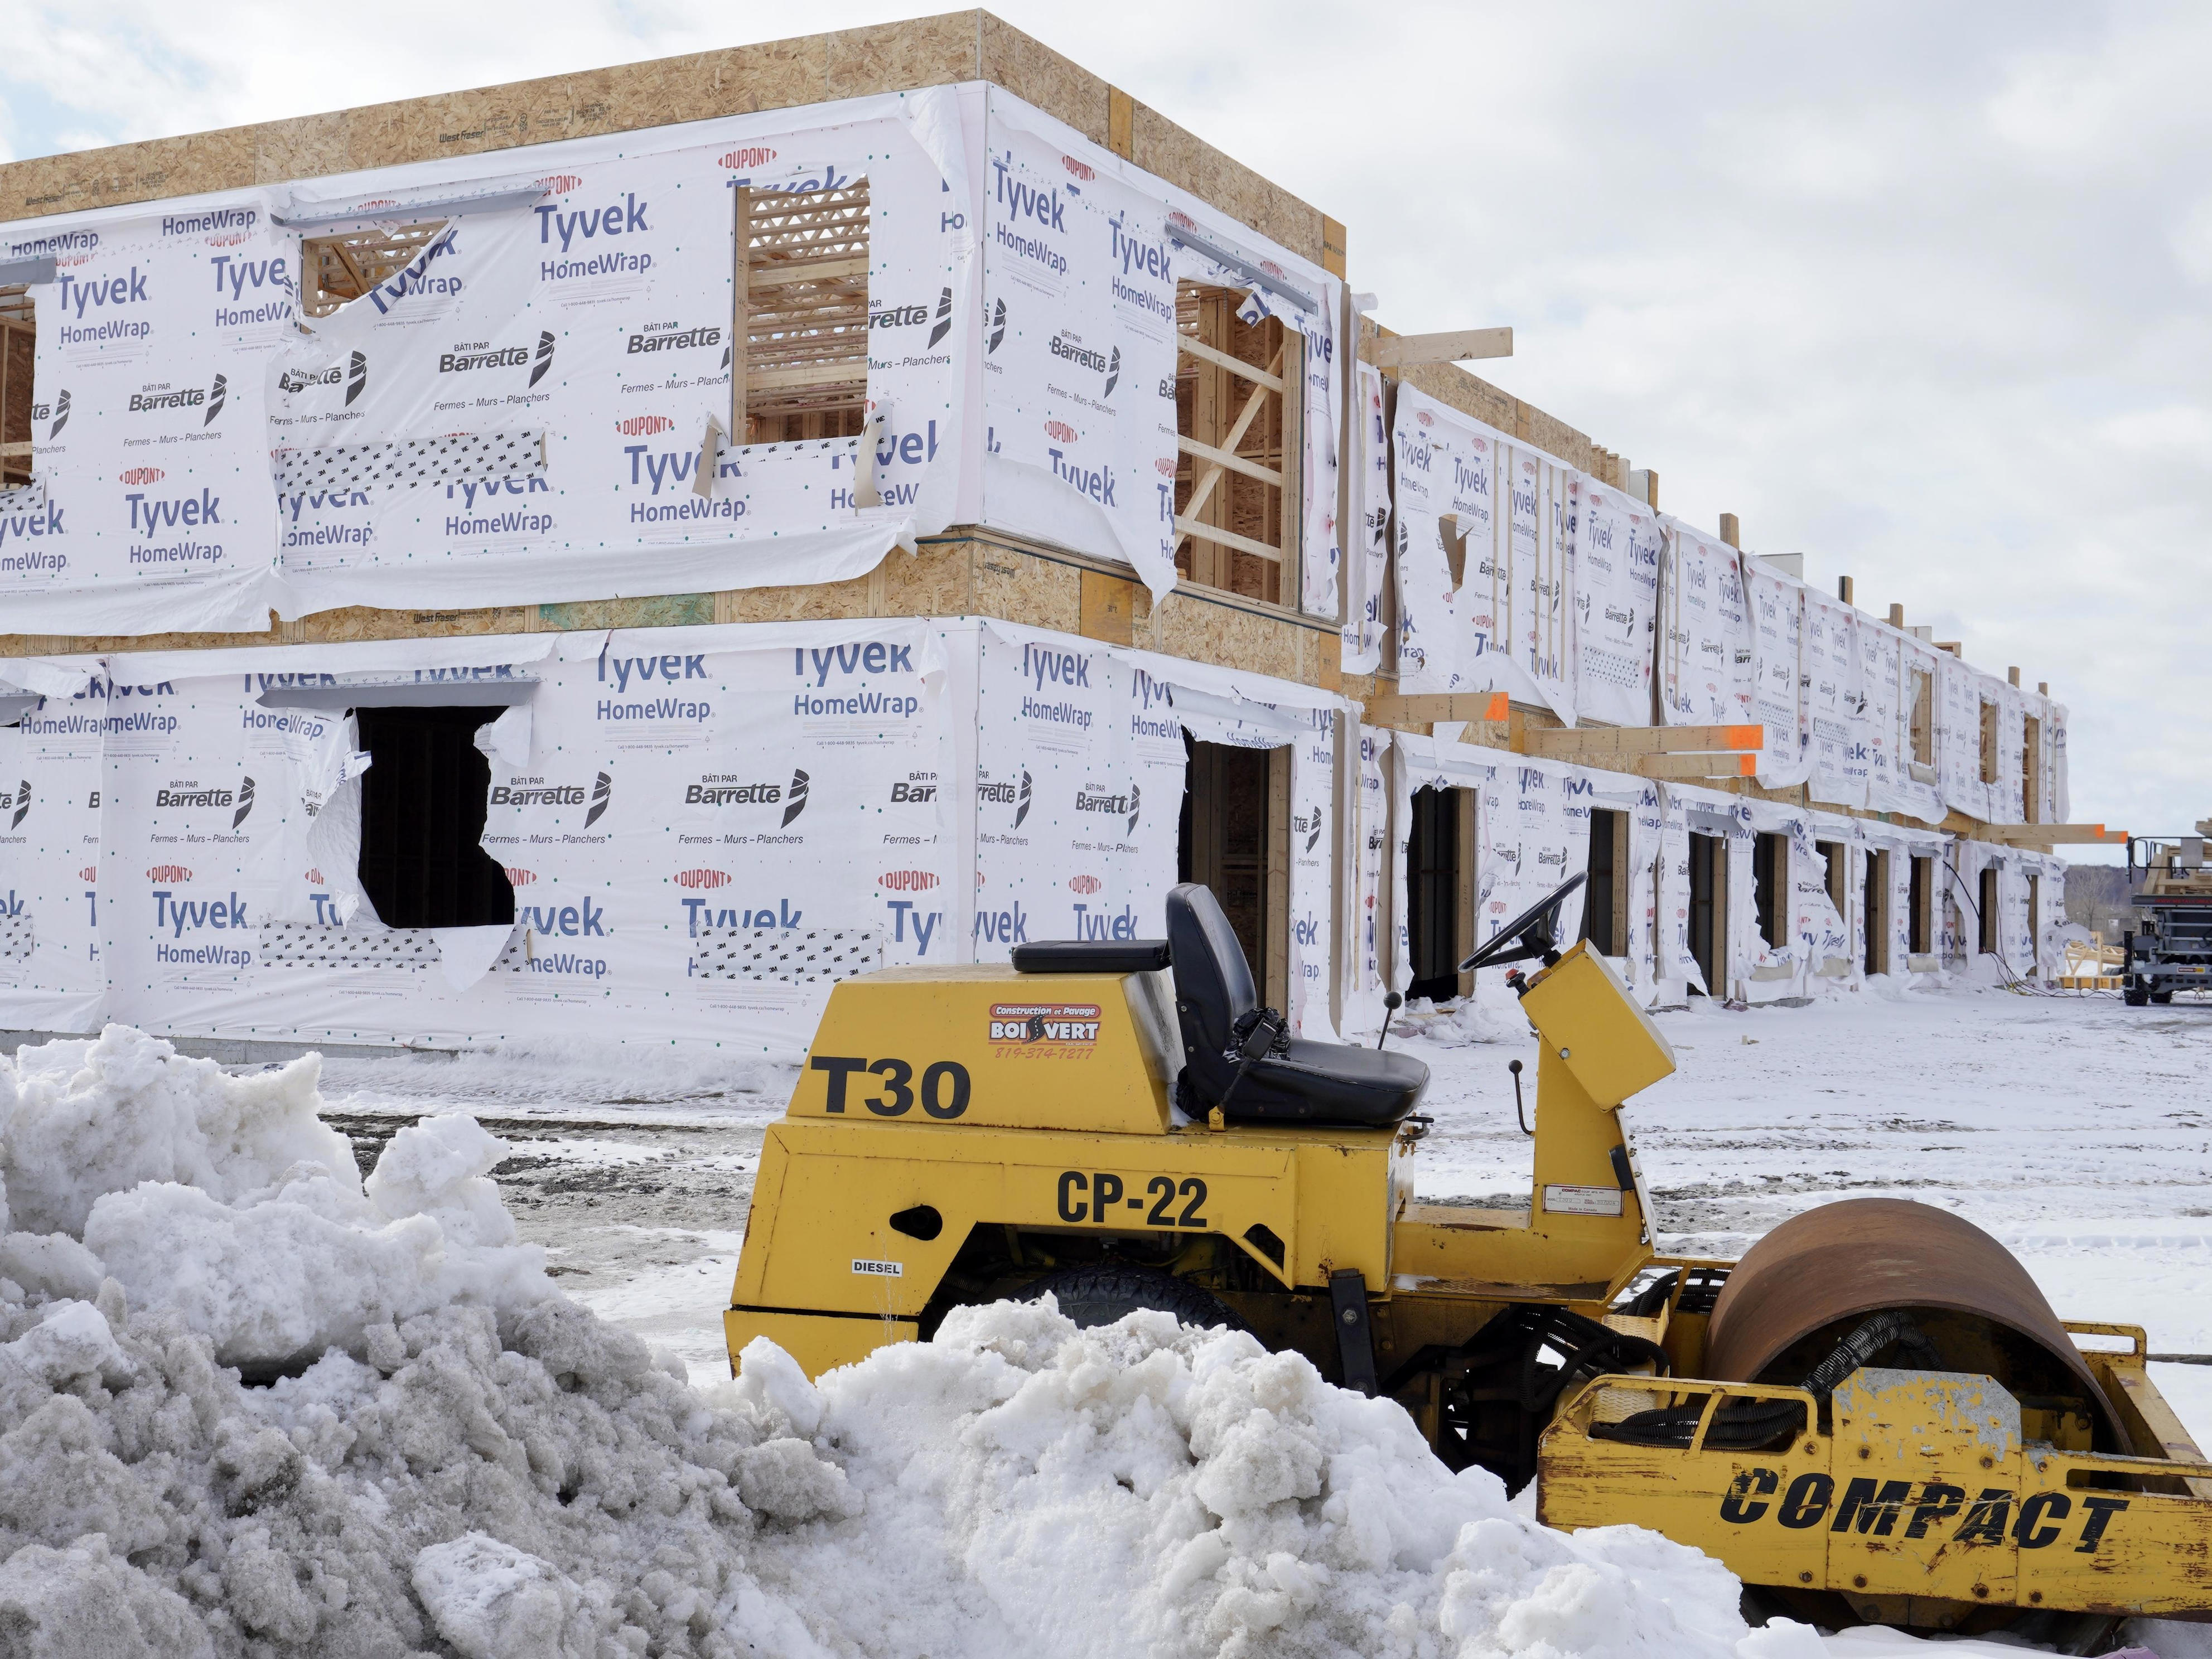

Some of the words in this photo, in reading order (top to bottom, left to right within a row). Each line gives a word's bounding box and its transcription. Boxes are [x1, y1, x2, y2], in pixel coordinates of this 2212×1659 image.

[439, 133, 459, 143] West
[725, 148, 771, 169] DUPONT
[1066, 155, 1093, 182] DUPONT
[993, 151, 1064, 233] Tyvek
[162, 209, 255, 236] HomeWrap
[534, 193, 648, 253] Tyvek
[997, 222, 1066, 276] HomeWrap
[1109, 210, 1171, 284] Tyvek
[542, 252, 651, 280] HomeWrap
[61, 267, 148, 318] Tyvek
[1113, 276, 1172, 323] HomeWrap
[60, 320, 150, 344] HomeWrap
[644, 323, 661, 332] BÂTI
[663, 321, 678, 331] PAR
[455, 342, 470, 352] BÂTI
[472, 342, 489, 351] PAR
[627, 327, 721, 354] Barrette
[439, 347, 528, 373] Barrette
[903, 354, 950, 366] Planchers
[1051, 335, 1106, 373] Barrette
[142, 383, 156, 391] BÂTI
[621, 383, 654, 394] Fermes
[665, 379, 688, 390] Murs
[697, 375, 730, 387] Planch
[129, 389, 204, 412] Barrette
[434, 400, 465, 411] Fermes
[476, 396, 498, 408] Murs
[507, 393, 549, 404] Planchers
[1047, 384, 1068, 399] Fermes
[1074, 393, 1088, 407] Murs
[1091, 399, 1116, 417] Planchers
[624, 415, 667, 436] DUPONT
[1049, 420, 1075, 443] DUPONT
[123, 438, 151, 447] Fermes
[160, 434, 177, 444] Murs
[185, 431, 221, 442] Planchers
[125, 467, 161, 485] DUPONT
[1455, 457, 1488, 496] Tyvek
[125, 488, 220, 539] Tyvek
[631, 499, 746, 523] HomeWrap
[1452, 496, 1488, 522] HomeWrap
[446, 512, 552, 535] HomeWrap
[130, 541, 223, 564] HomeWrap
[414, 613, 434, 623] West
[598, 698, 710, 722] HomeWrap
[794, 693, 917, 718] HomeWrap
[1023, 695, 1091, 727] HomeWrap
[170, 780, 183, 789] BÂTI
[702, 773, 719, 782] BÂTI
[909, 770, 928, 780] BÂTI
[156, 789, 232, 807] Barrette
[491, 786, 585, 805] Barrette
[685, 783, 780, 804] Barrette
[151, 834, 178, 843] Fermes
[186, 835, 205, 843] Murs
[213, 834, 249, 844] Planchers
[482, 834, 519, 844] Fermes
[530, 834, 553, 844] Murs
[563, 834, 605, 844] Planchers
[679, 834, 713, 844] Fermes
[725, 835, 746, 844] Murs
[757, 834, 803, 844] Planchers
[883, 835, 920, 845] Fermes
[981, 834, 996, 844] Murs
[1001, 835, 1028, 846] Planchers
[1072, 840, 1091, 851] Fermes
[1097, 842, 1110, 852] Murs
[152, 865, 188, 883] DUPONT
[681, 869, 725, 889] DUPONT
[886, 870, 935, 891] DUPONT
[1073, 875, 1098, 895] DUPONT
[153, 892, 248, 938] Tyvek
[157, 944, 250, 969] HomeWrap
[996, 1006, 1052, 1015] Construction
[1063, 1007, 1096, 1017] Pavage
[995, 1047, 1094, 1060] 819-374-7277
[810, 1056, 971, 1119] T30
[1058, 1171, 1207, 1227] CP-22
[854, 1262, 900, 1274] DIESEL
[1720, 1468, 2130, 1554] COMPACT
